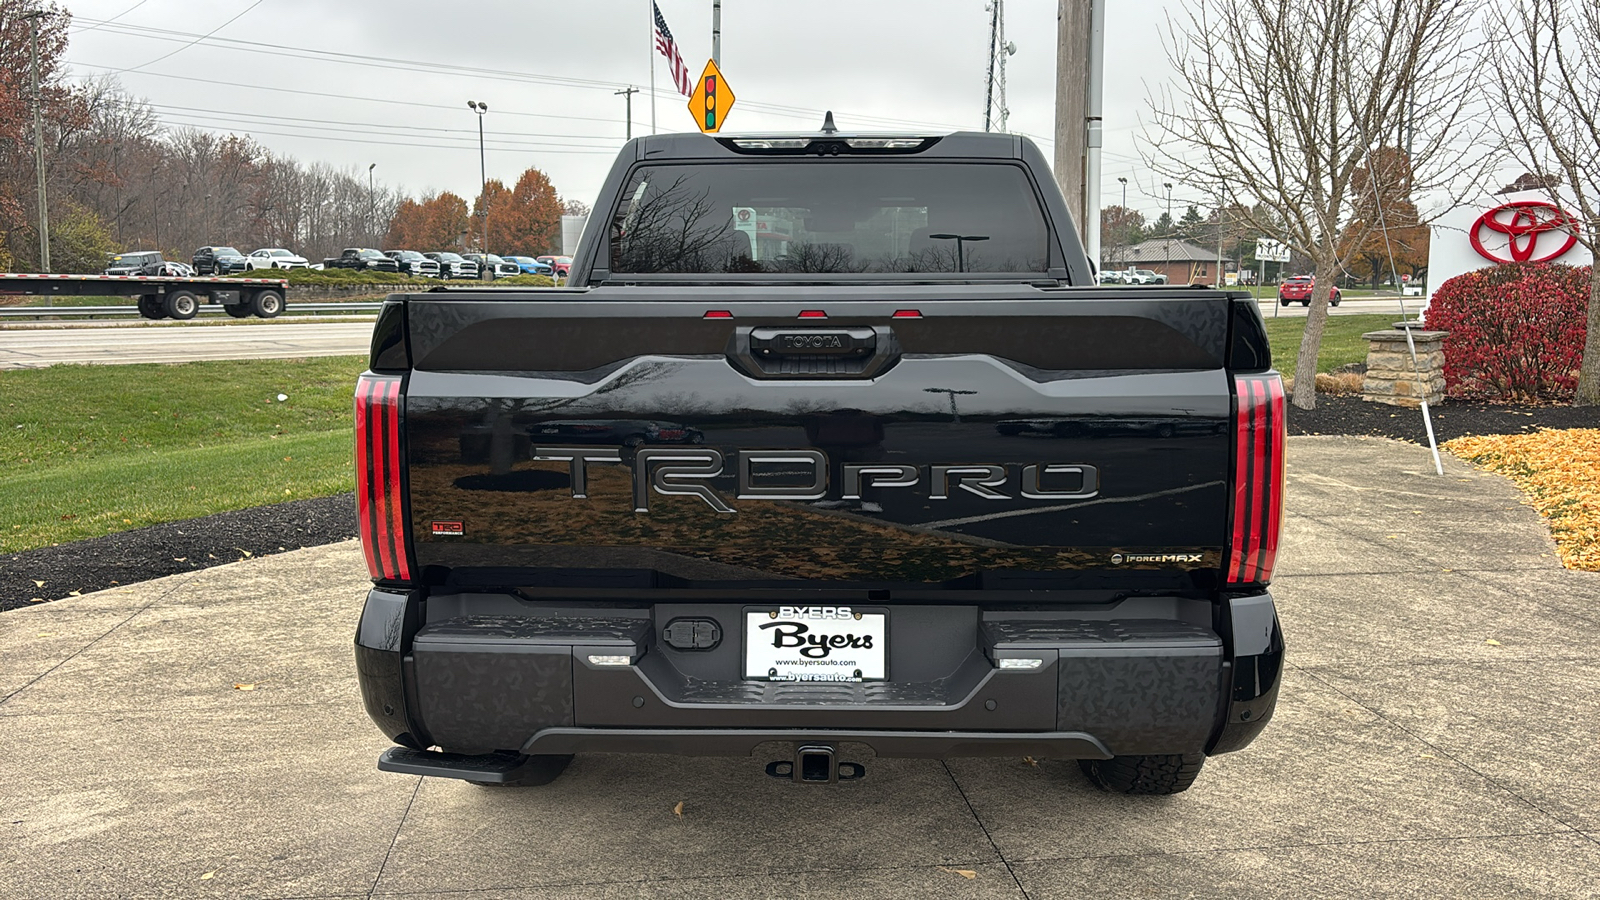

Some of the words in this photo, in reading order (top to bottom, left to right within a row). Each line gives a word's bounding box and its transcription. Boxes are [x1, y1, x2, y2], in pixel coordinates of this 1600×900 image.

[784, 335, 842, 347] TOYOTA
[532, 447, 829, 513] TRD
[841, 463, 1098, 499] PRO
[433, 522, 462, 532] TRD
[779, 606, 852, 620] BYERS
[758, 621, 873, 659] Byers
[775, 659, 857, 667] www.byersauto.com
[769, 672, 862, 682] www.byersauto.com
